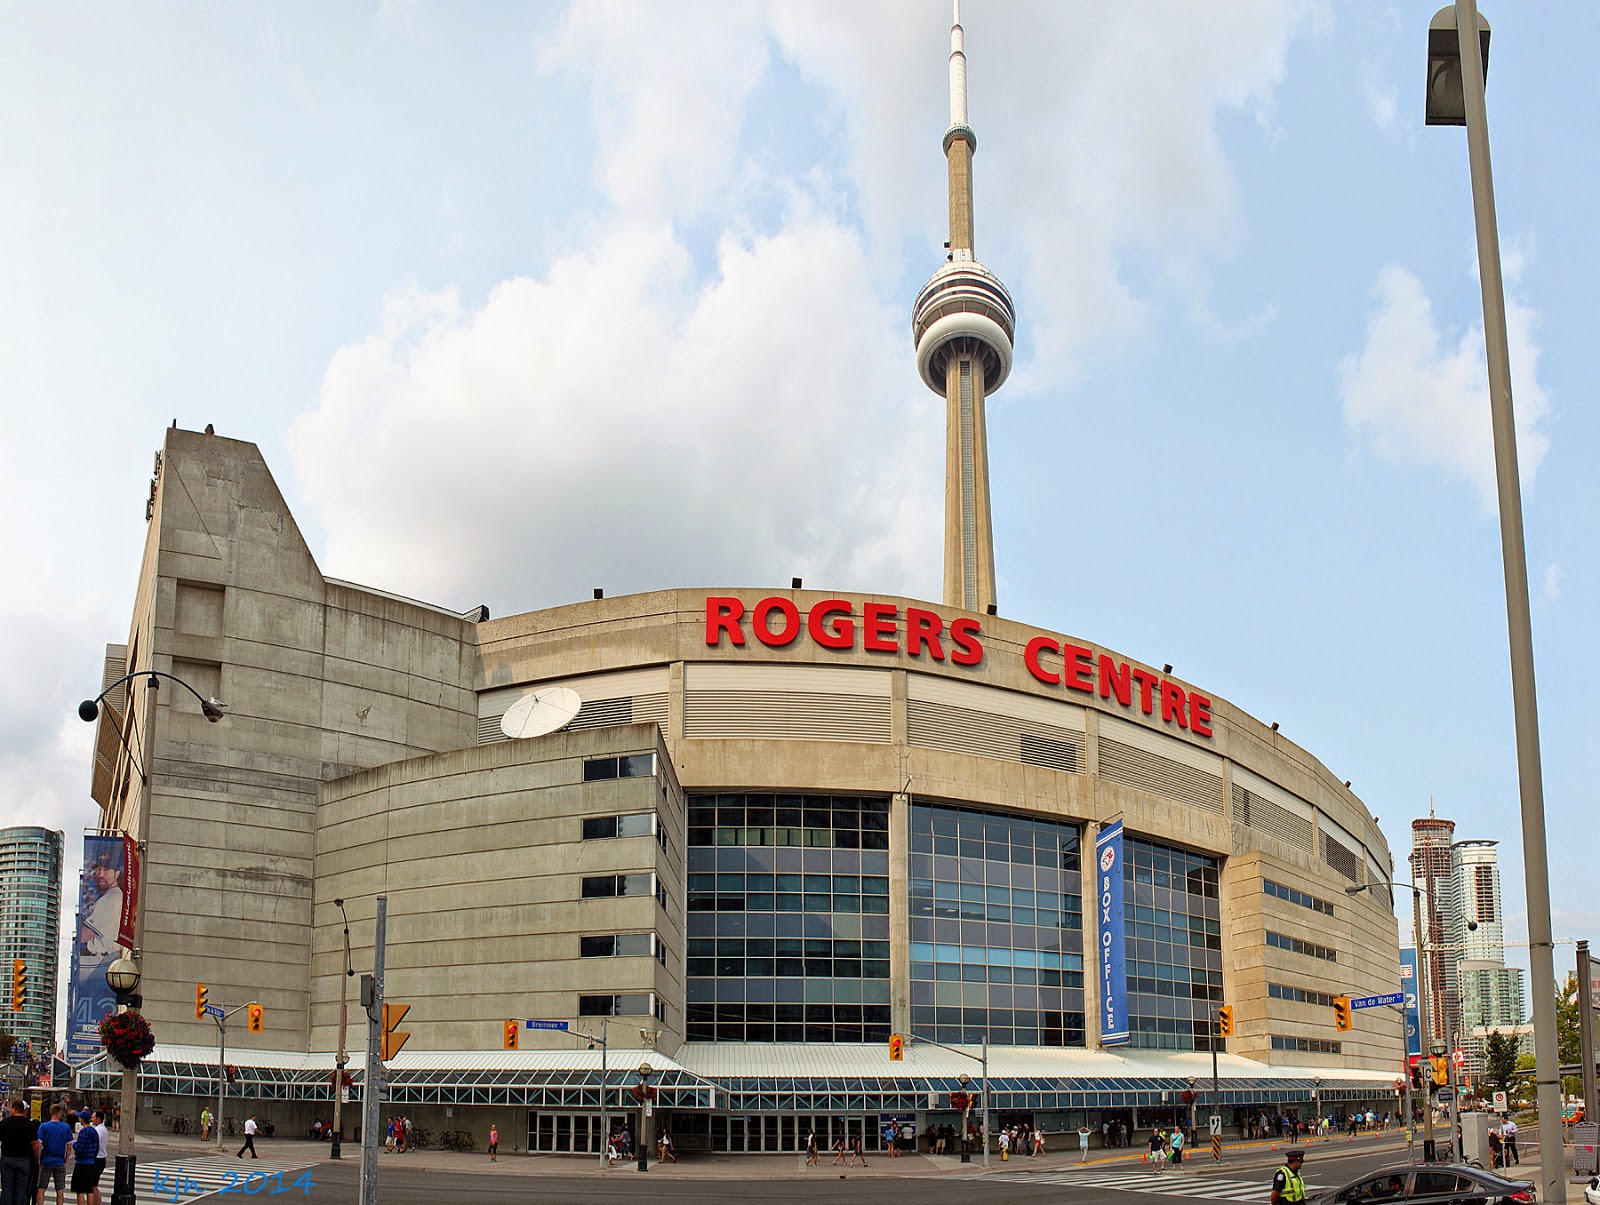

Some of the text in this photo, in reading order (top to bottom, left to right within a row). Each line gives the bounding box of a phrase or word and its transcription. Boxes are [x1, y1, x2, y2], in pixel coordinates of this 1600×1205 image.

[705, 596, 1213, 737] ROGERS CENTRE
[1102, 876, 1112, 924] BOX
[1102, 931, 1115, 1029] OFFICE
[1353, 999, 1367, 1008] Van
[1367, 998, 1376, 1006] de
[1377, 995, 1396, 1005] Water
[531, 1021, 559, 1029] Bremner
